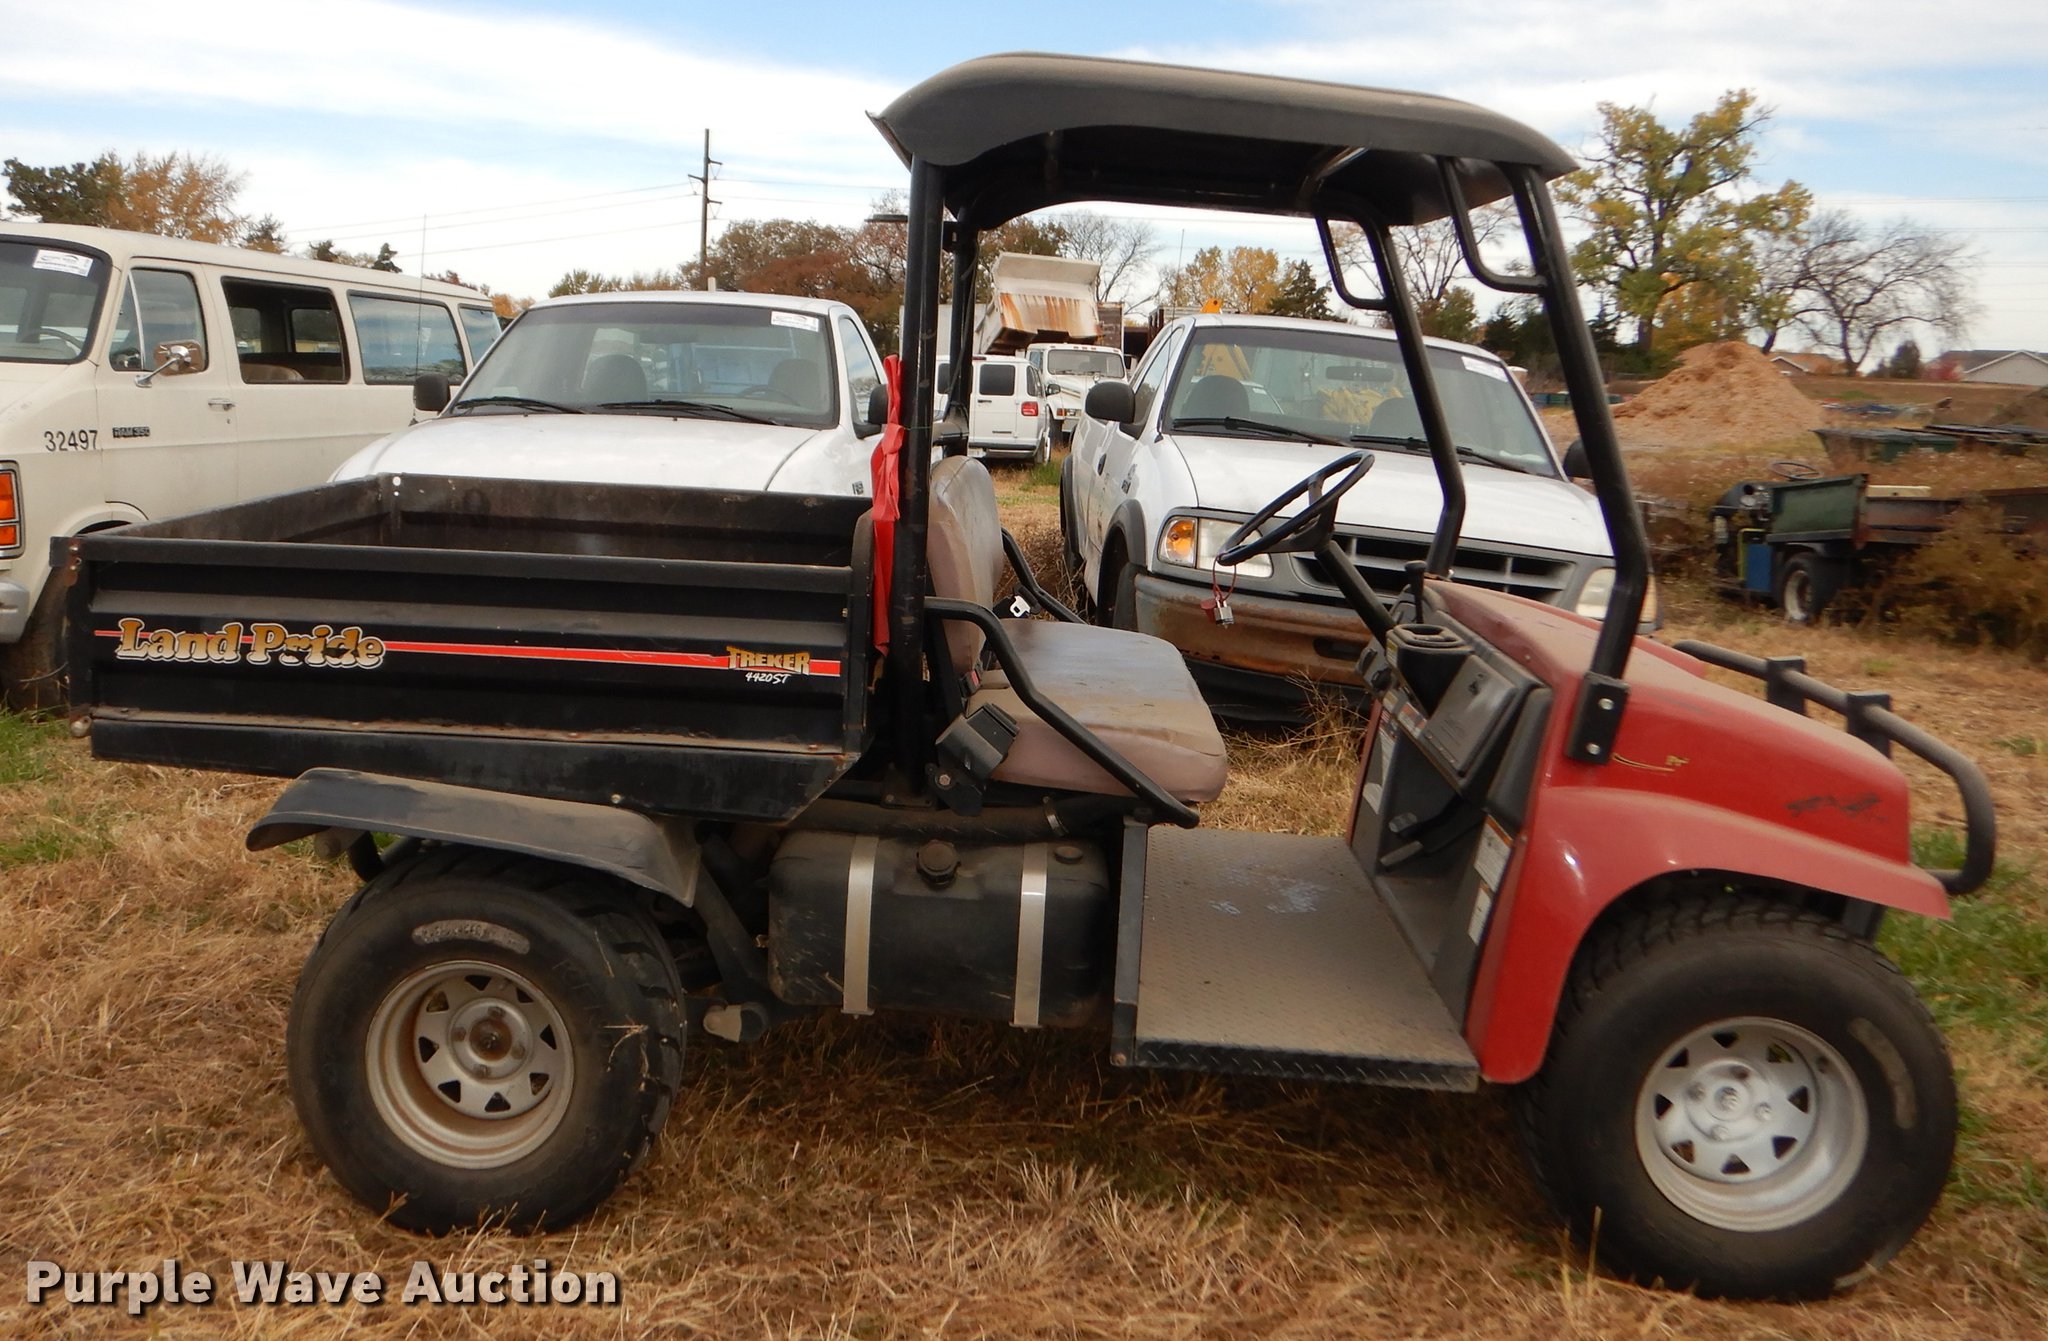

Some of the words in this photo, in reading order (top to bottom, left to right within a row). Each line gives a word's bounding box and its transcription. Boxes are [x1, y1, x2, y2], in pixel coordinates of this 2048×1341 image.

[44, 429, 98, 452] 32497
[116, 618, 243, 663] Land
[247, 622, 387, 669] Pride
[726, 645, 811, 675] TREKER
[745, 671, 792, 684] 4420ST
